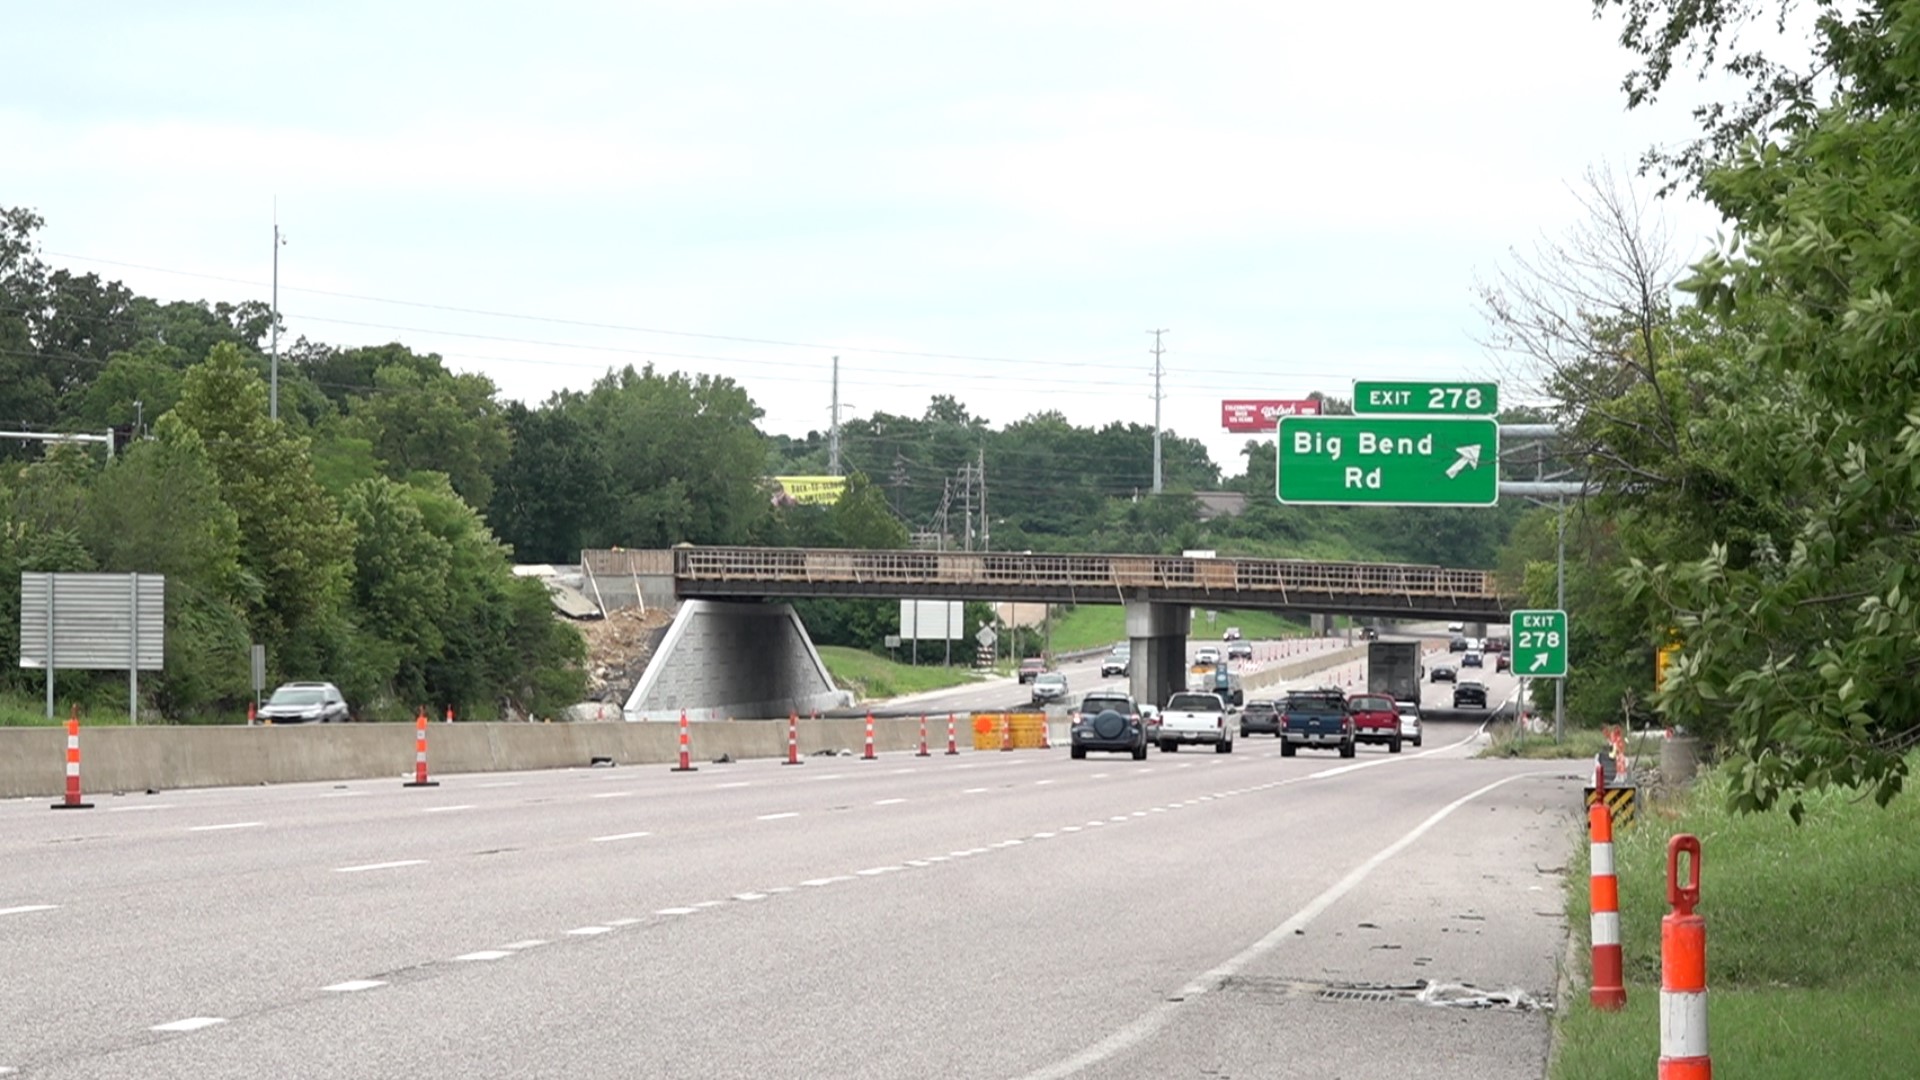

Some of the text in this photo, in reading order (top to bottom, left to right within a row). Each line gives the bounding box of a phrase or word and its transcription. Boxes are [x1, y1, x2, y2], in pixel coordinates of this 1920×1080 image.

[1369, 387, 1482, 410] EXIT 278
[1293, 431, 1433, 461] Big Bend
[1344, 466, 1382, 489] Rd
[1522, 615, 1555, 628] EXIT
[1518, 631, 1560, 648] 278
